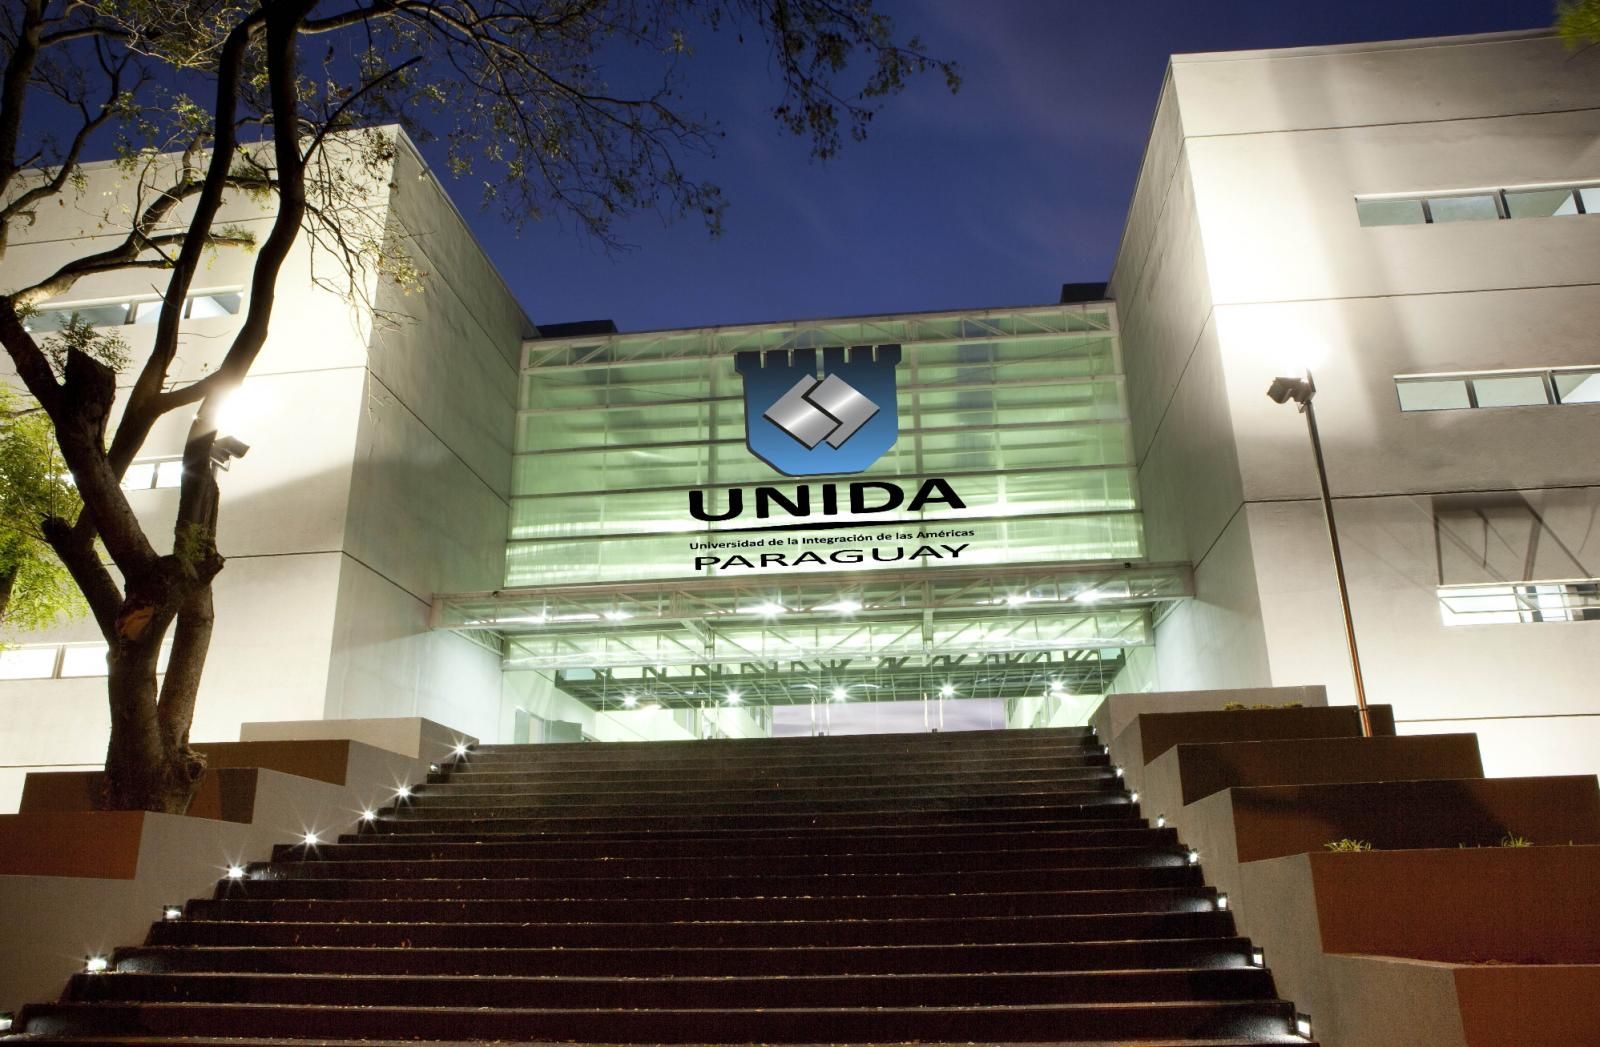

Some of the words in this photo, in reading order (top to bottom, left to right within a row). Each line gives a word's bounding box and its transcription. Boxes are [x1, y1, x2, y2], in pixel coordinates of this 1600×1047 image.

[688, 478, 967, 521] UNIDA
[689, 539, 765, 550] Universidad
[768, 538, 784, 546] de
[787, 537, 799, 545] la
[802, 533, 873, 545] Integración
[877, 532, 893, 541] de
[896, 532, 914, 540] las
[916, 529, 975, 539] Américas
[694, 543, 970, 571] PARAGUAY
